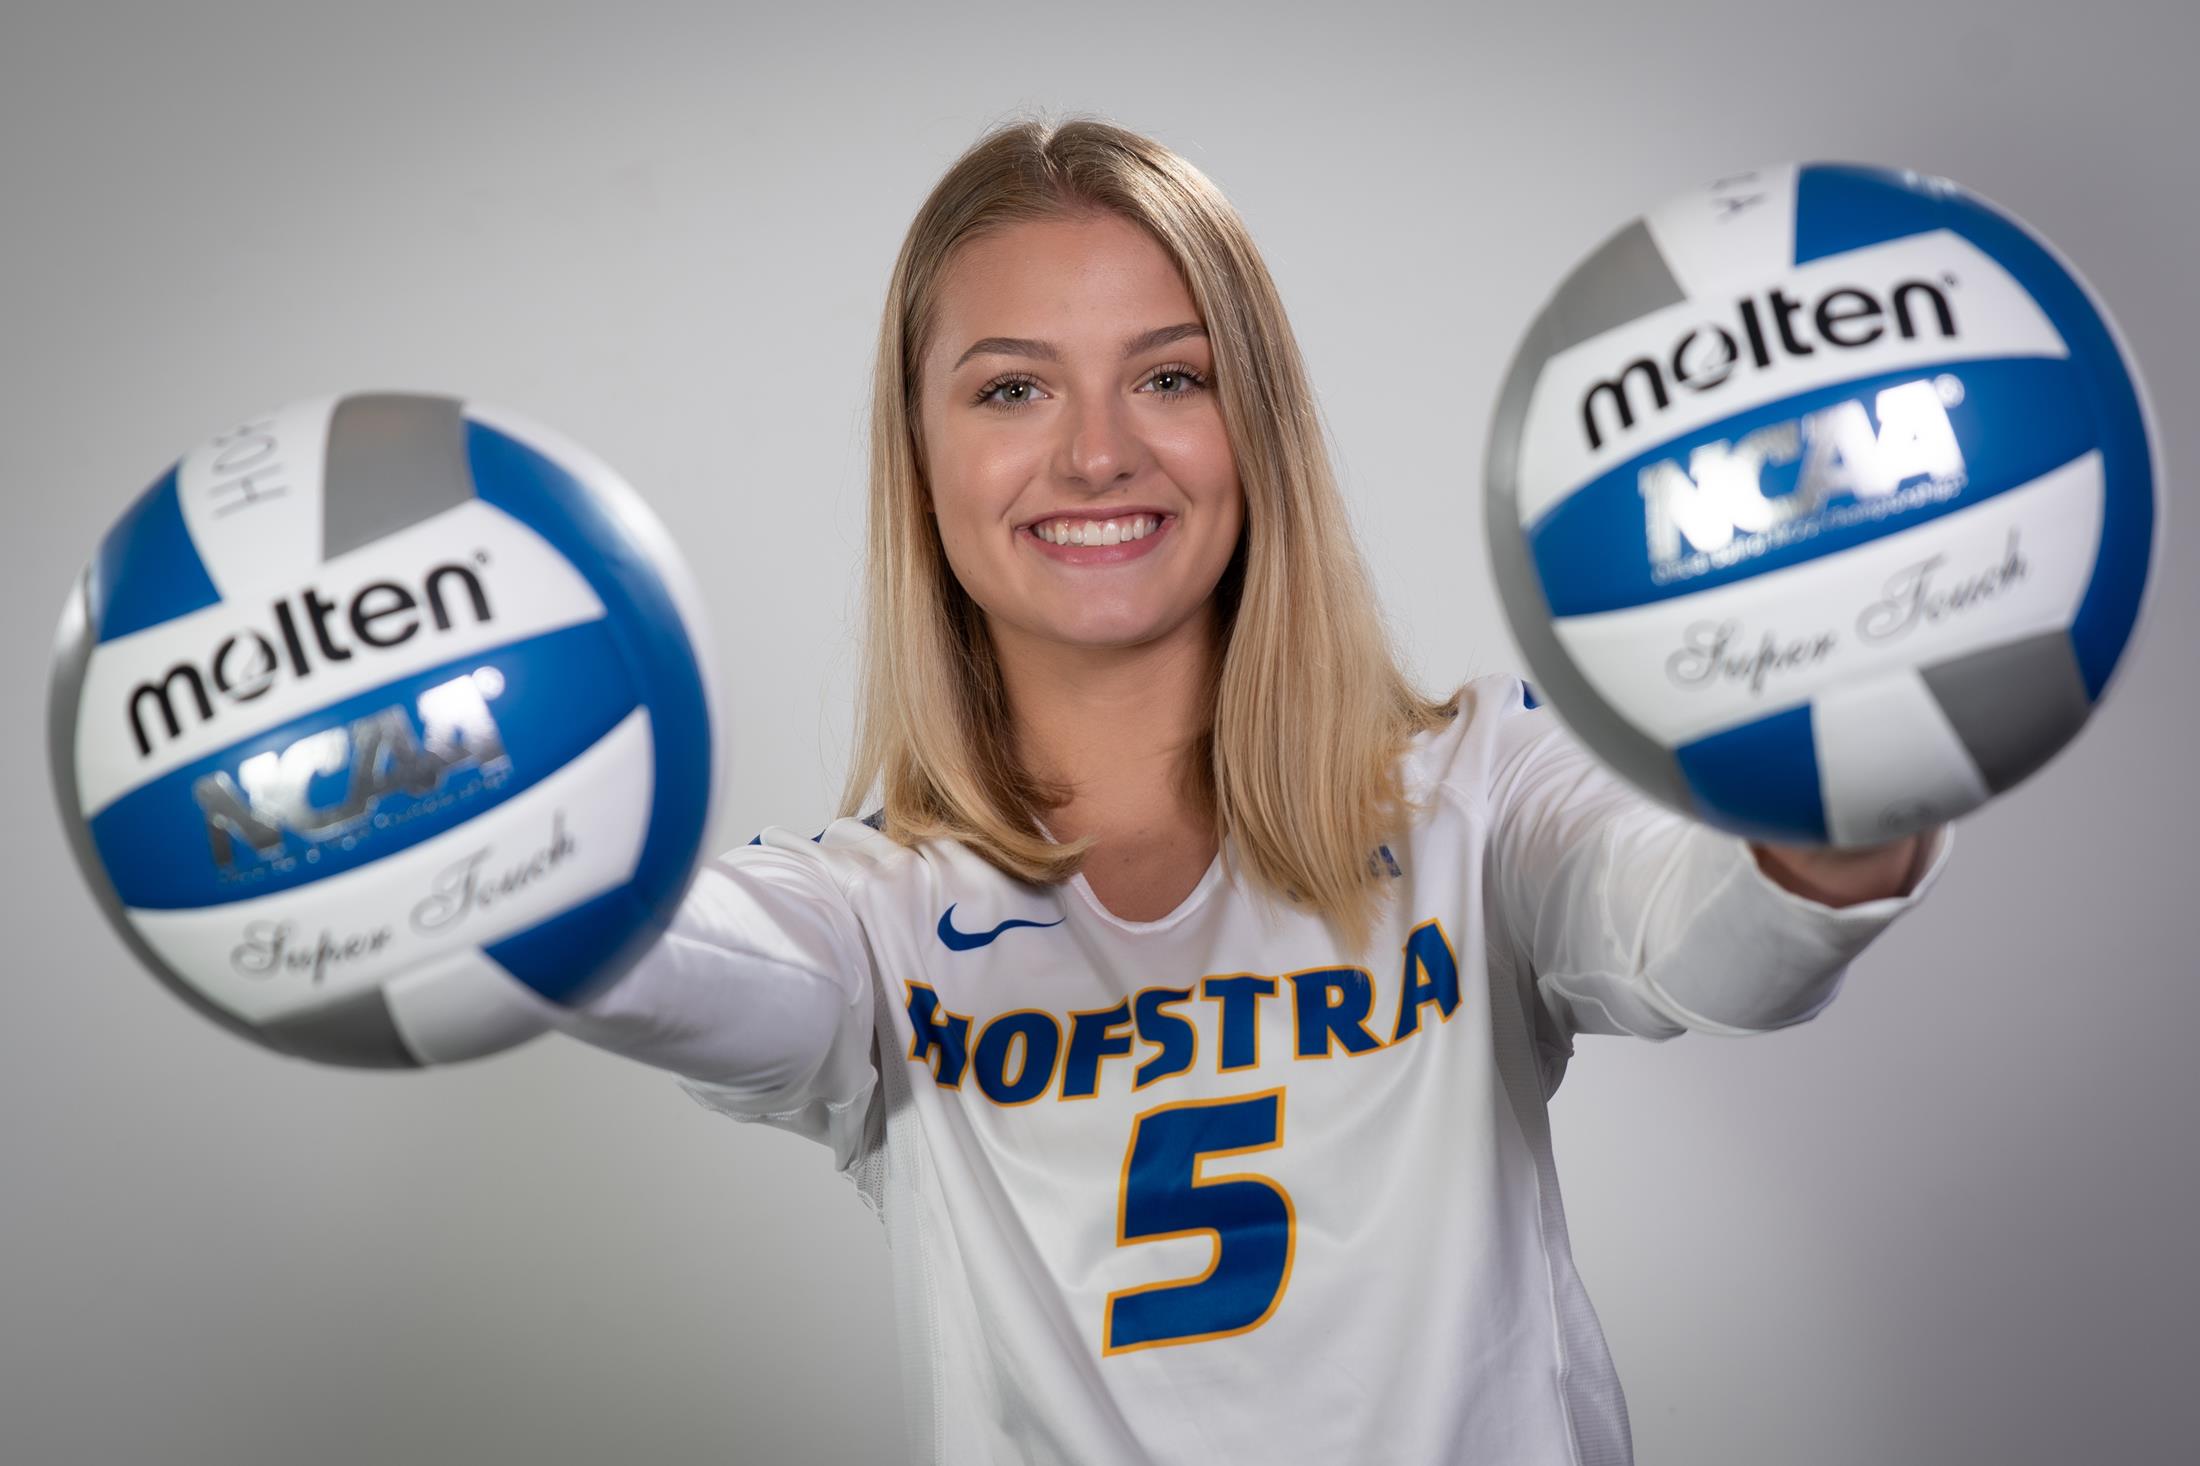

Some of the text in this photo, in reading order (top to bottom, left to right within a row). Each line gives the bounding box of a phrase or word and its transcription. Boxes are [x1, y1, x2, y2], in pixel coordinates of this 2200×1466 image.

[1580, 277, 1957, 451] molten
[1639, 378, 1965, 566] NCAA
[128, 562, 491, 756] molten
[1665, 619, 1839, 694] Super
[1855, 524, 2029, 647] Touch
[193, 674, 512, 868] NCAA
[231, 919, 392, 984] Super
[409, 808, 576, 936] Touch
[904, 918, 1463, 1107] HOFSTRA
[1102, 1086, 1297, 1357] 5
